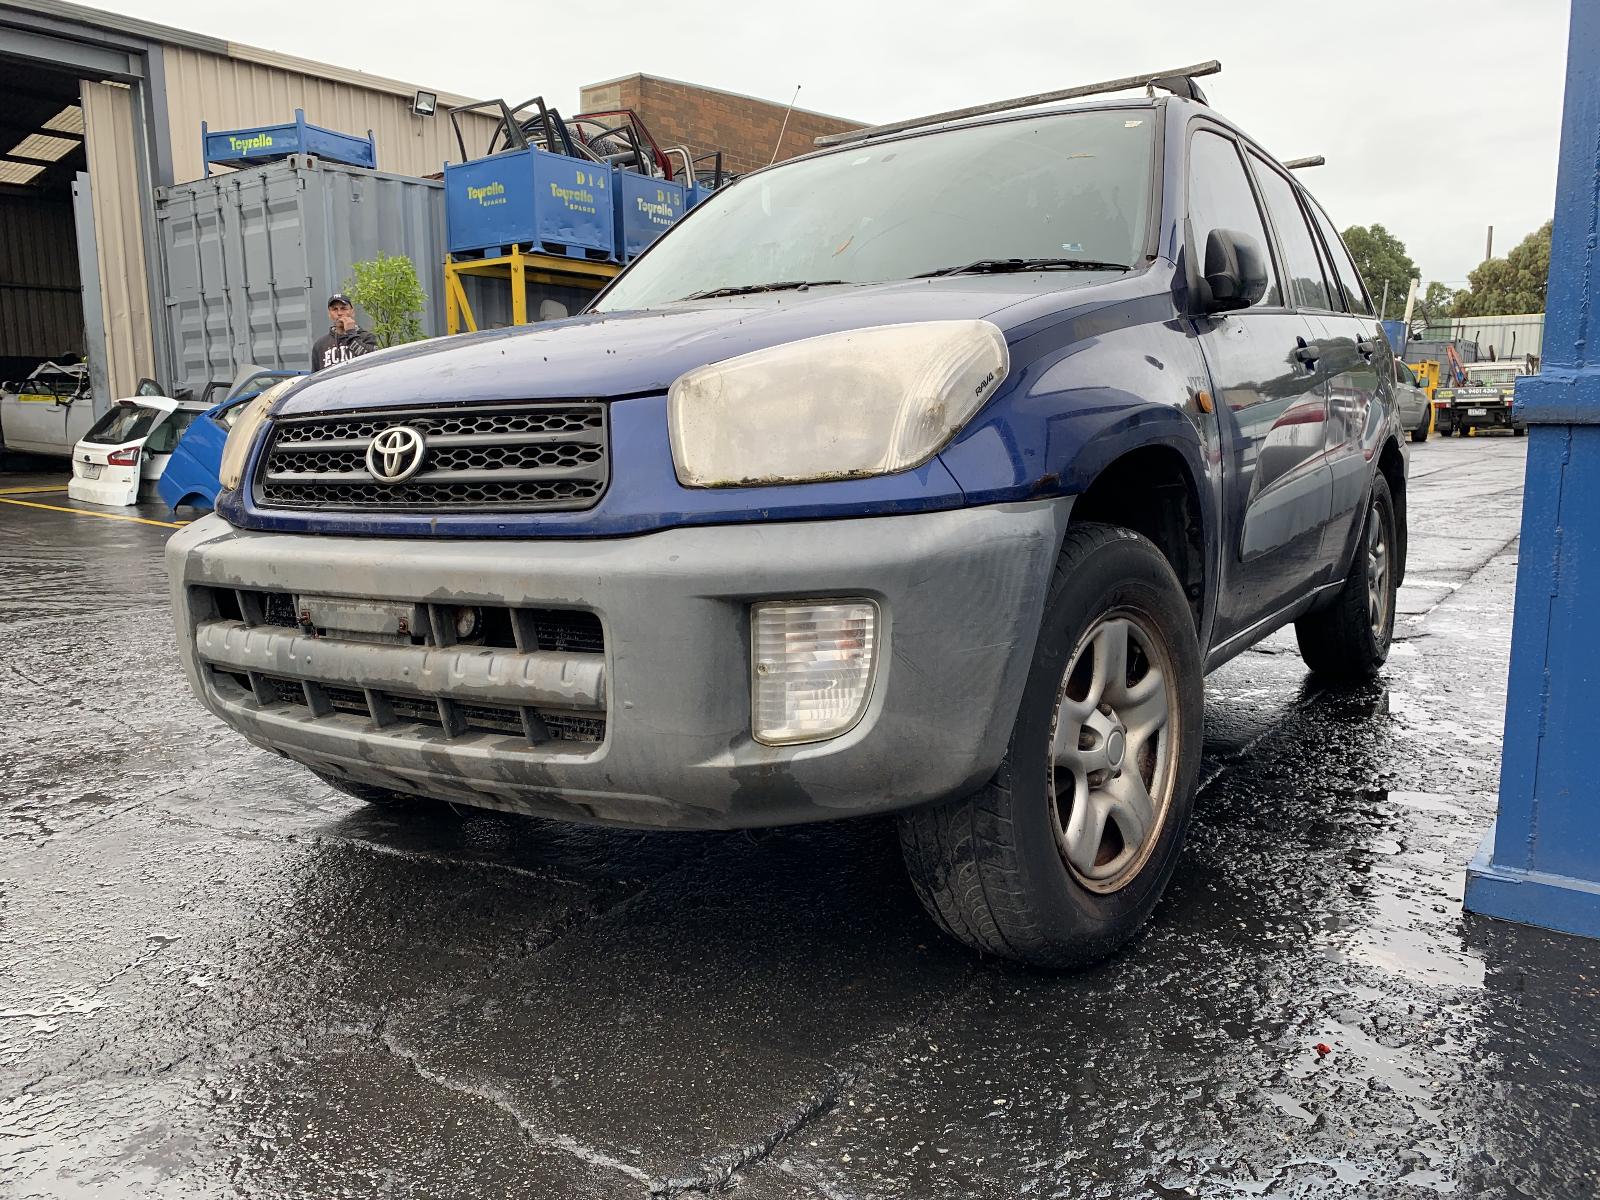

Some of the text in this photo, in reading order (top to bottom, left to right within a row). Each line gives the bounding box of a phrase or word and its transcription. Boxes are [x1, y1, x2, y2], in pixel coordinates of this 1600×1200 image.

[467, 181, 505, 204] Toyrolla
[550, 183, 594, 206] Toyrolla
[636, 197, 673, 219] Toyrolla
[975, 371, 994, 397] RAV4
